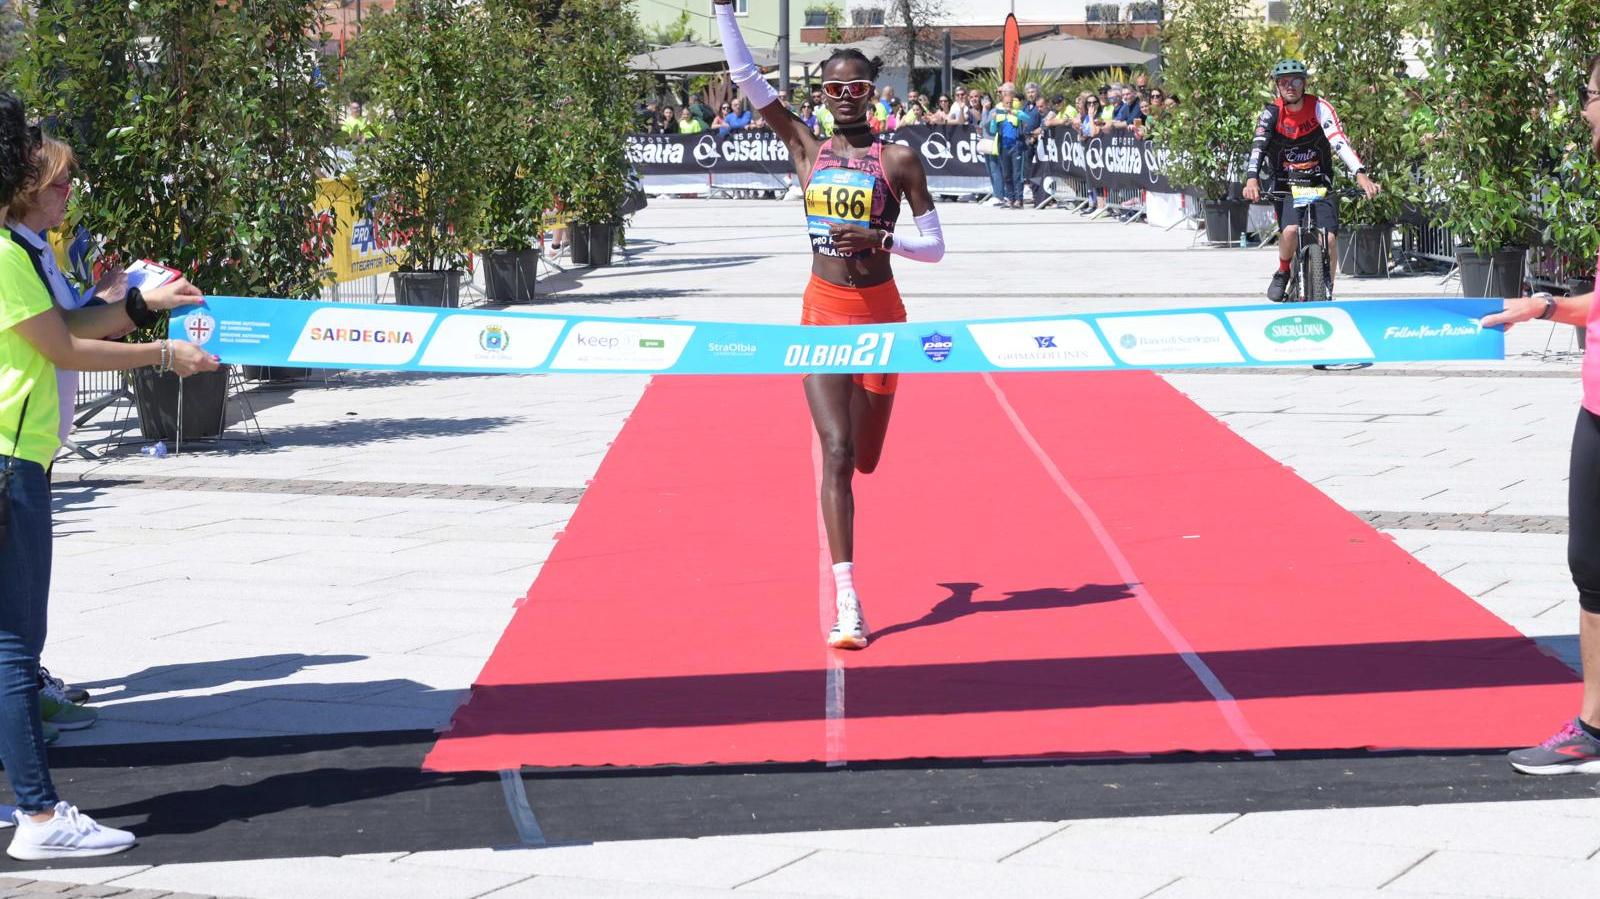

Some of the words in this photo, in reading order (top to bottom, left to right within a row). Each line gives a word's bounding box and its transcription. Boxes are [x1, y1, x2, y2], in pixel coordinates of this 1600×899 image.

[721, 139, 788, 162] cisalfa
[1105, 146, 1142, 174] cisalfa
[823, 187, 866, 219] 186
[352, 227, 369, 243] PRO
[812, 236, 827, 246] PRO
[310, 326, 414, 344] SARDEGNA
[1271, 323, 1326, 338] SMERALDINA
[708, 342, 757, 353] StraOlbia
[923, 341, 953, 351] pao
